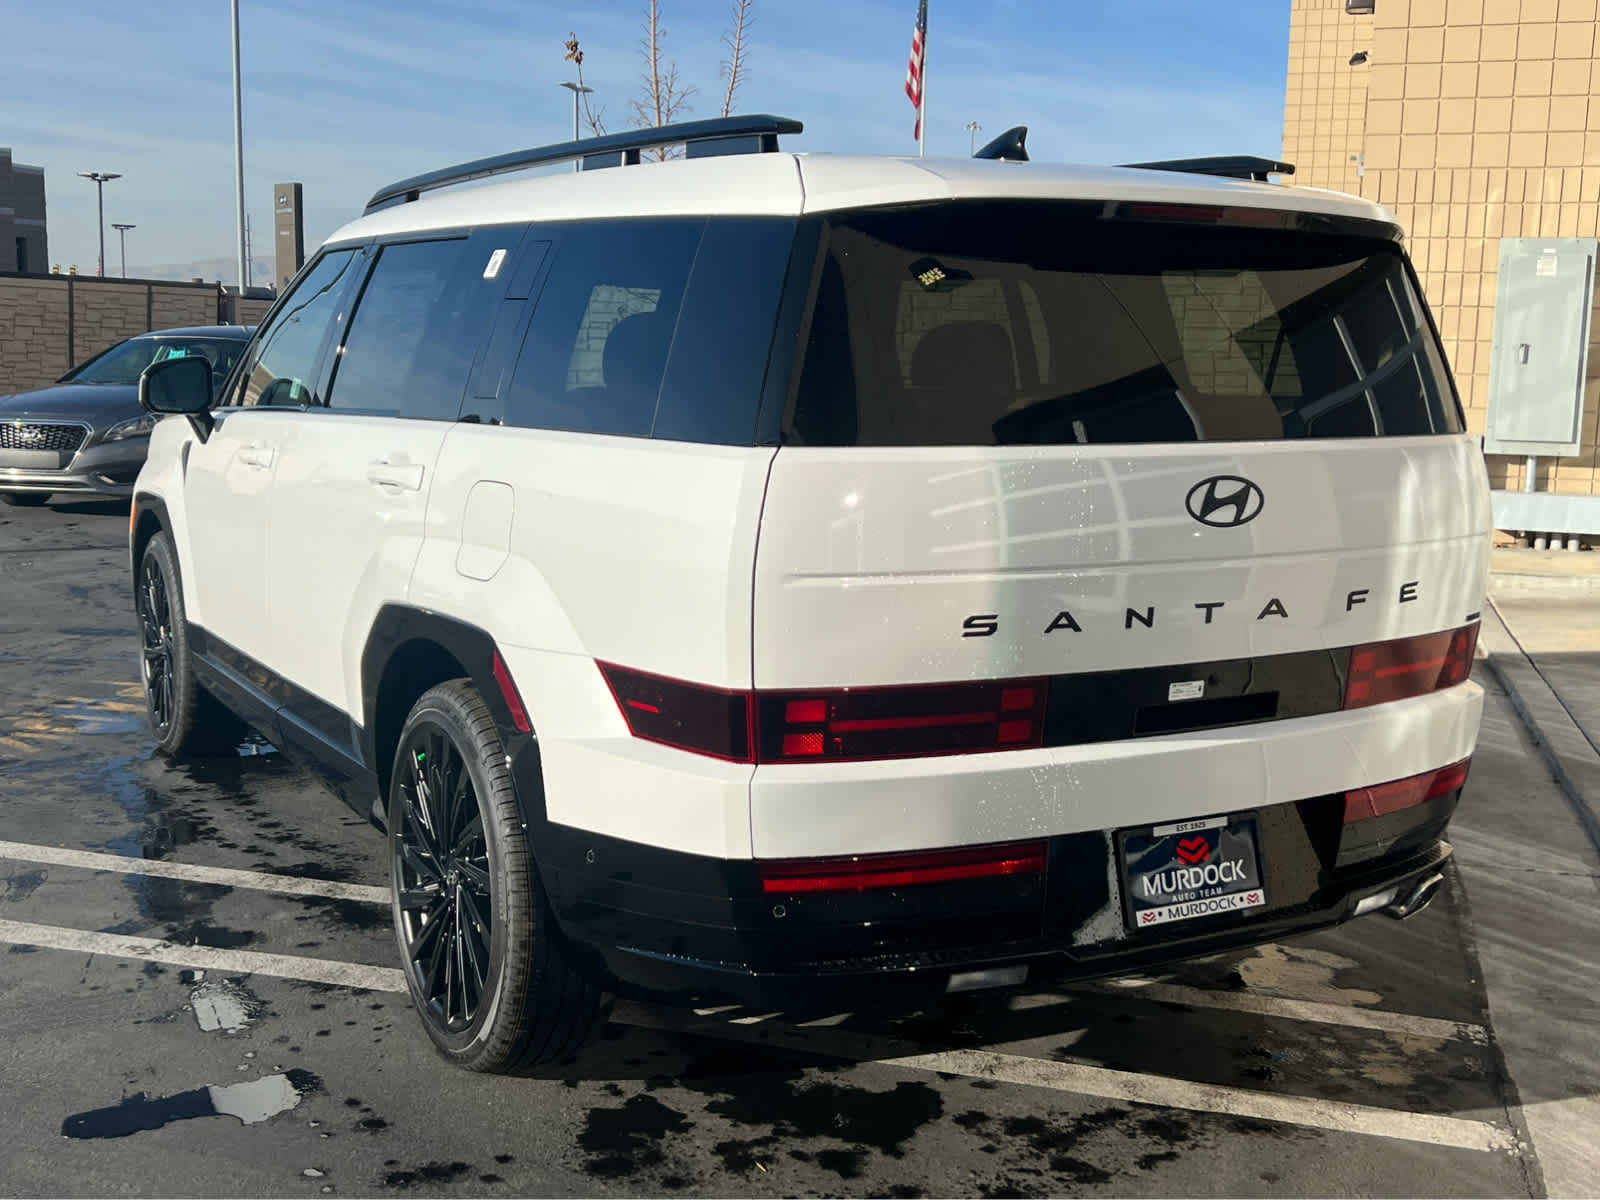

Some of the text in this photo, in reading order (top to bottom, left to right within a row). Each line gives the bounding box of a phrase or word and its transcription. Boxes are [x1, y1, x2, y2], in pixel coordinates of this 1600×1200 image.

[962, 581, 1419, 638] SANTA FE
[1142, 859, 1247, 897] MURDOCK
[1168, 896, 1238, 919] MURDOCK
[1172, 887, 1223, 902] AUTO TEAM
